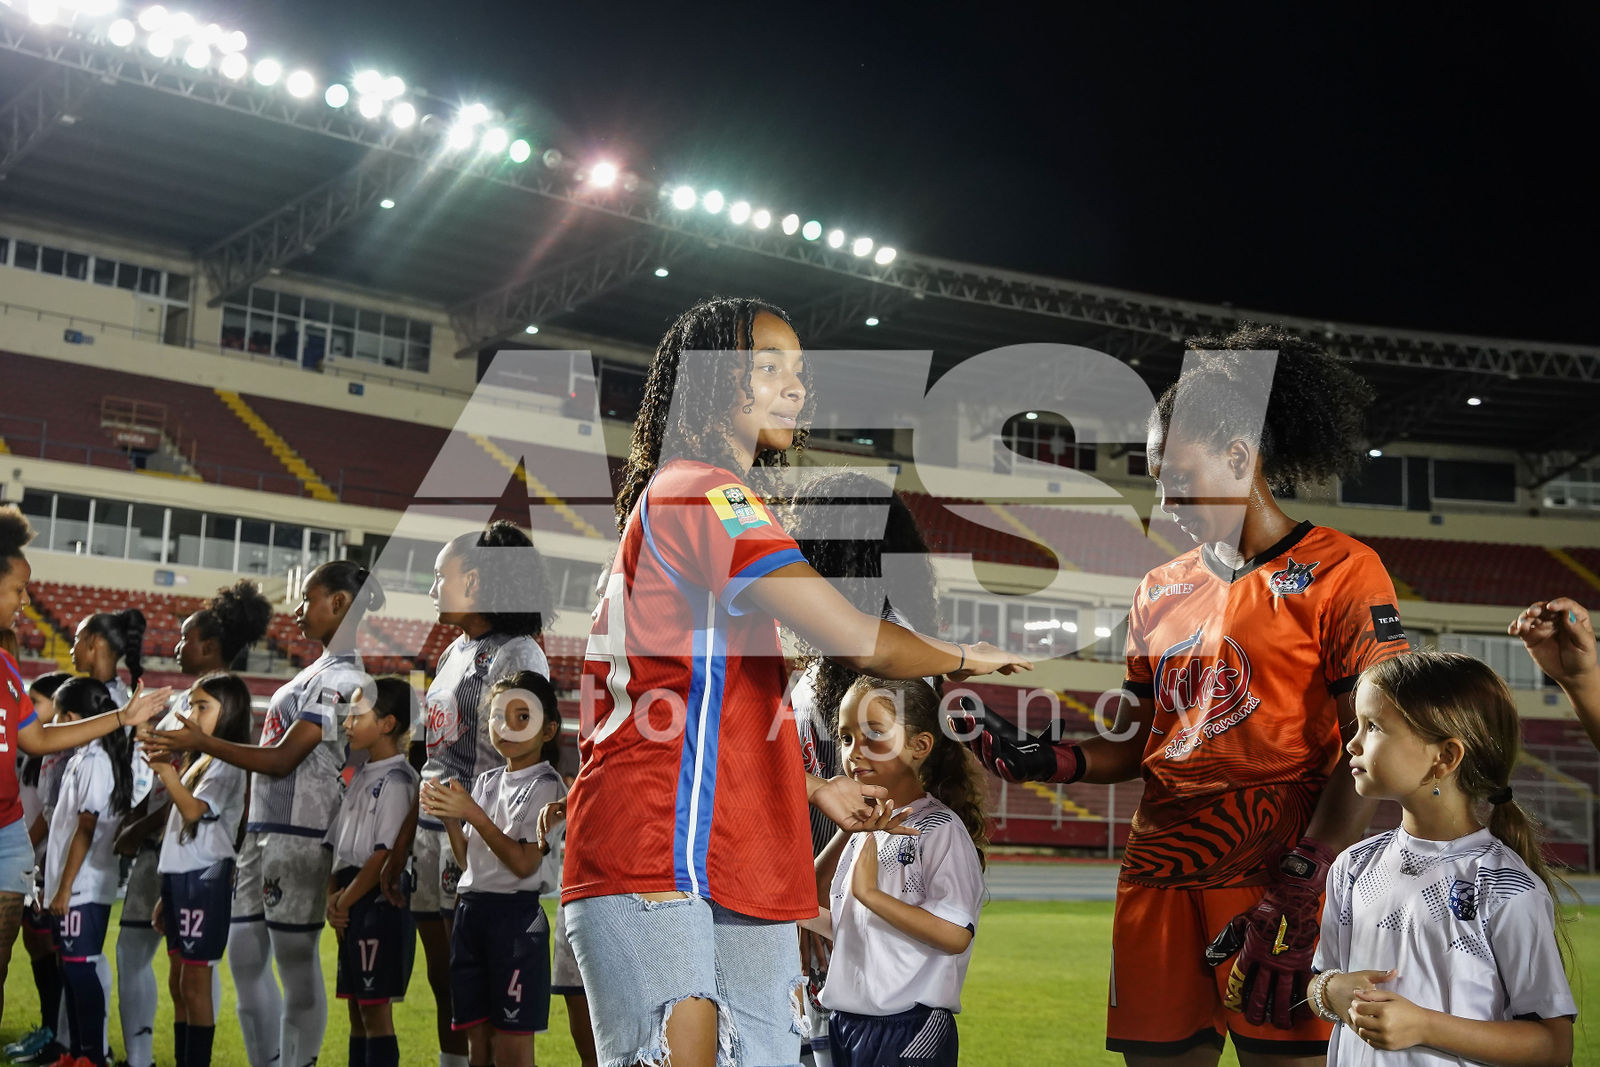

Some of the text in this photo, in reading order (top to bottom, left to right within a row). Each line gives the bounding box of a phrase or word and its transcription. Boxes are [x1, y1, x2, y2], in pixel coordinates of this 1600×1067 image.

[179, 908, 204, 938] 32
[358, 938, 379, 972] 17
[507, 969, 522, 1003] 4
